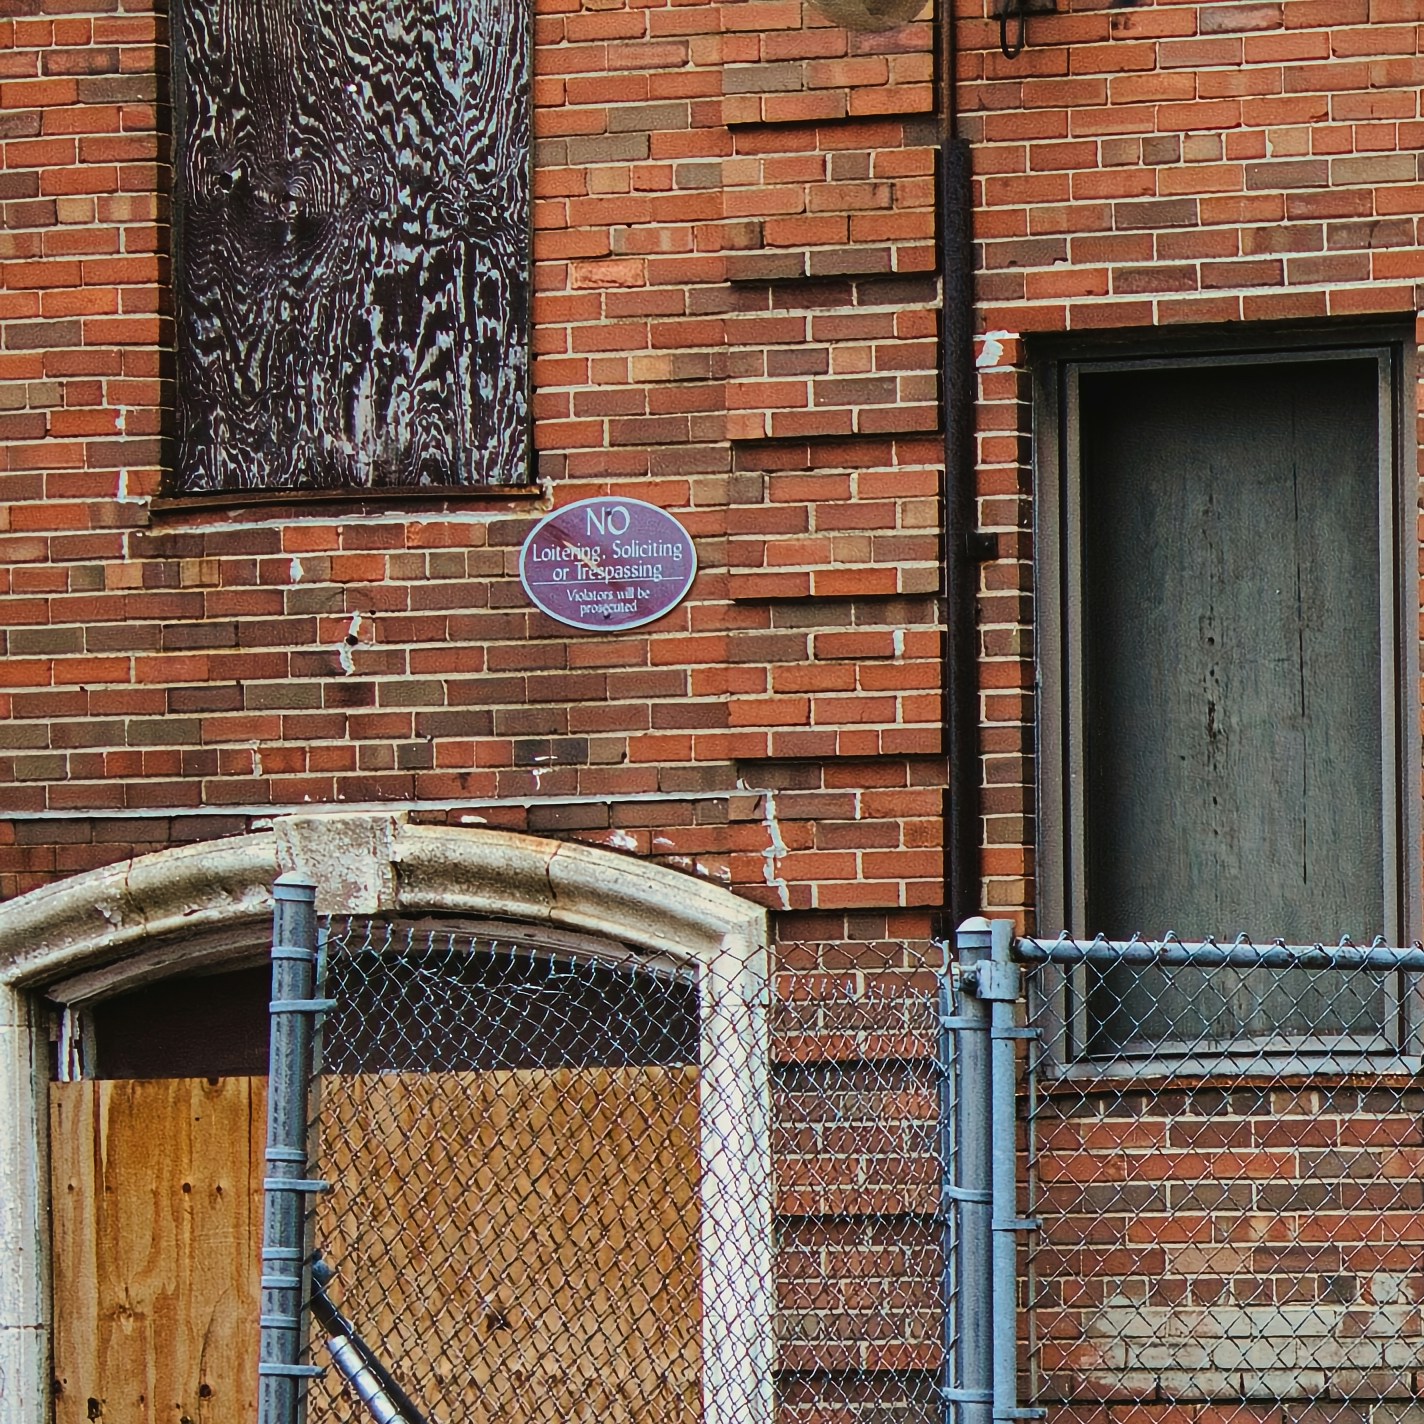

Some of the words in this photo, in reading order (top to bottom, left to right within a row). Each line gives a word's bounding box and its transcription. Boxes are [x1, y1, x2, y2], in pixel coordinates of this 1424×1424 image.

[586, 506, 630, 535] NO
[612, 540, 683, 561] Soliciting
[552, 567, 569, 581] or
[574, 561, 662, 584] Trespassing
[567, 588, 613, 602] Violators
[617, 587, 634, 599] will
[638, 587, 650, 599] be
[580, 600, 637, 617] prosecuted
